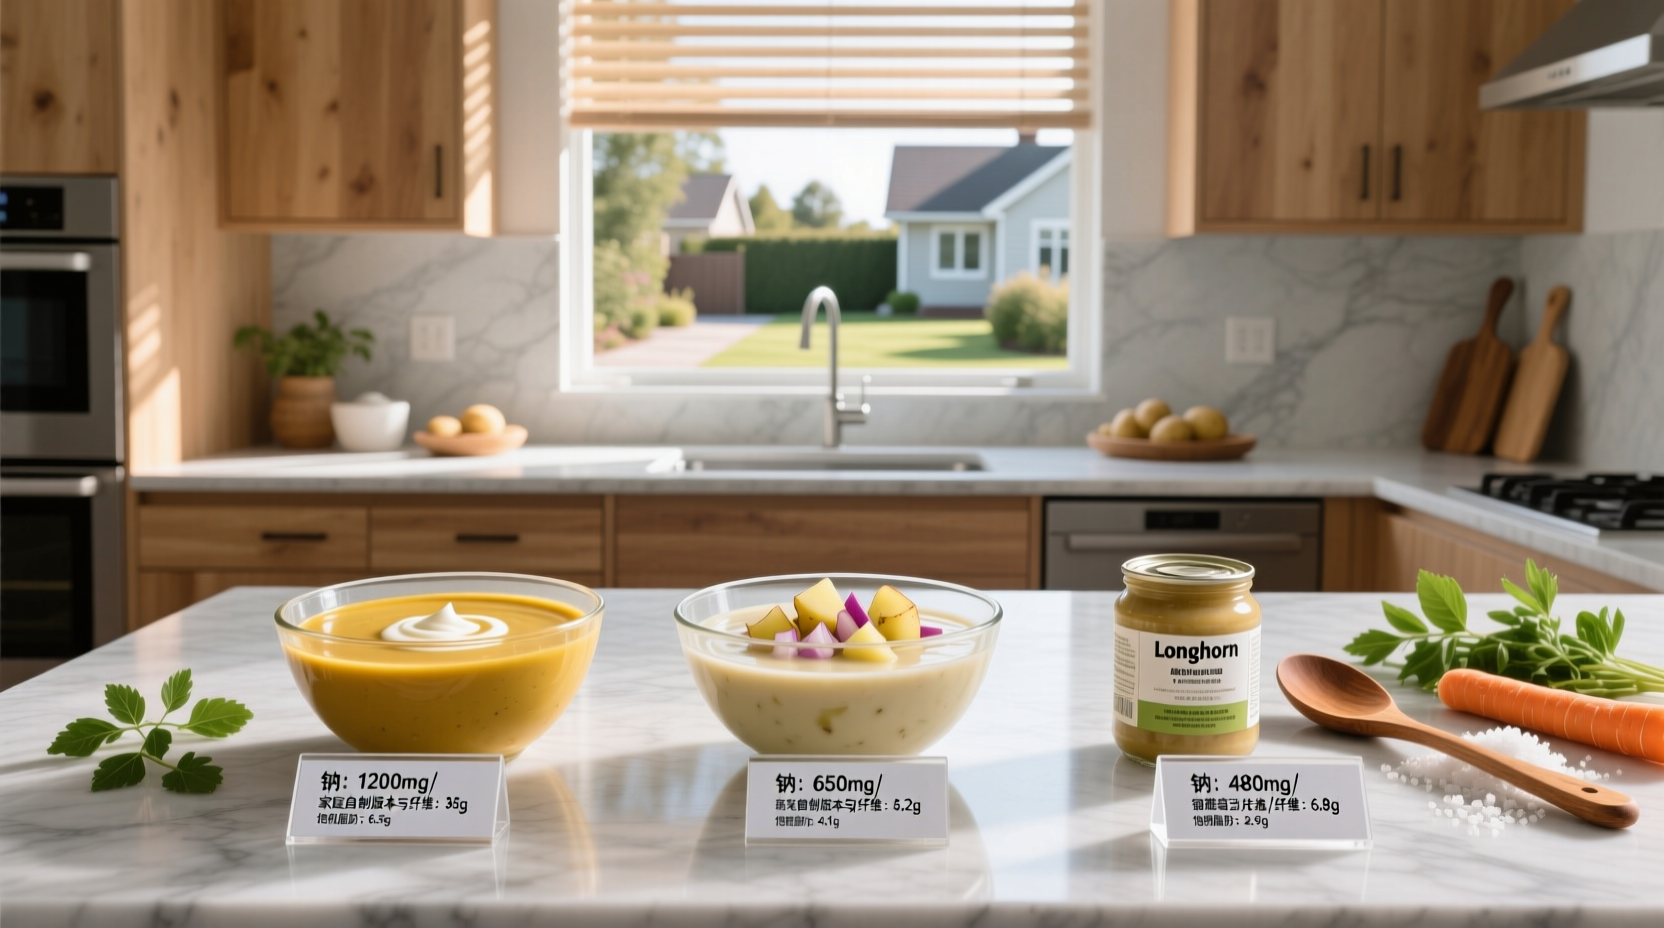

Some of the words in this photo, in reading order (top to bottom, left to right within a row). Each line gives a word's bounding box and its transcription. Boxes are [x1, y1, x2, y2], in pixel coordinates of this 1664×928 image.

[1154, 640, 1239, 664] Longhorn
[358, 771, 438, 796] 1200mg/
[812, 773, 883, 799] 650mg/
[1228, 772, 1299, 797] 480mg/
